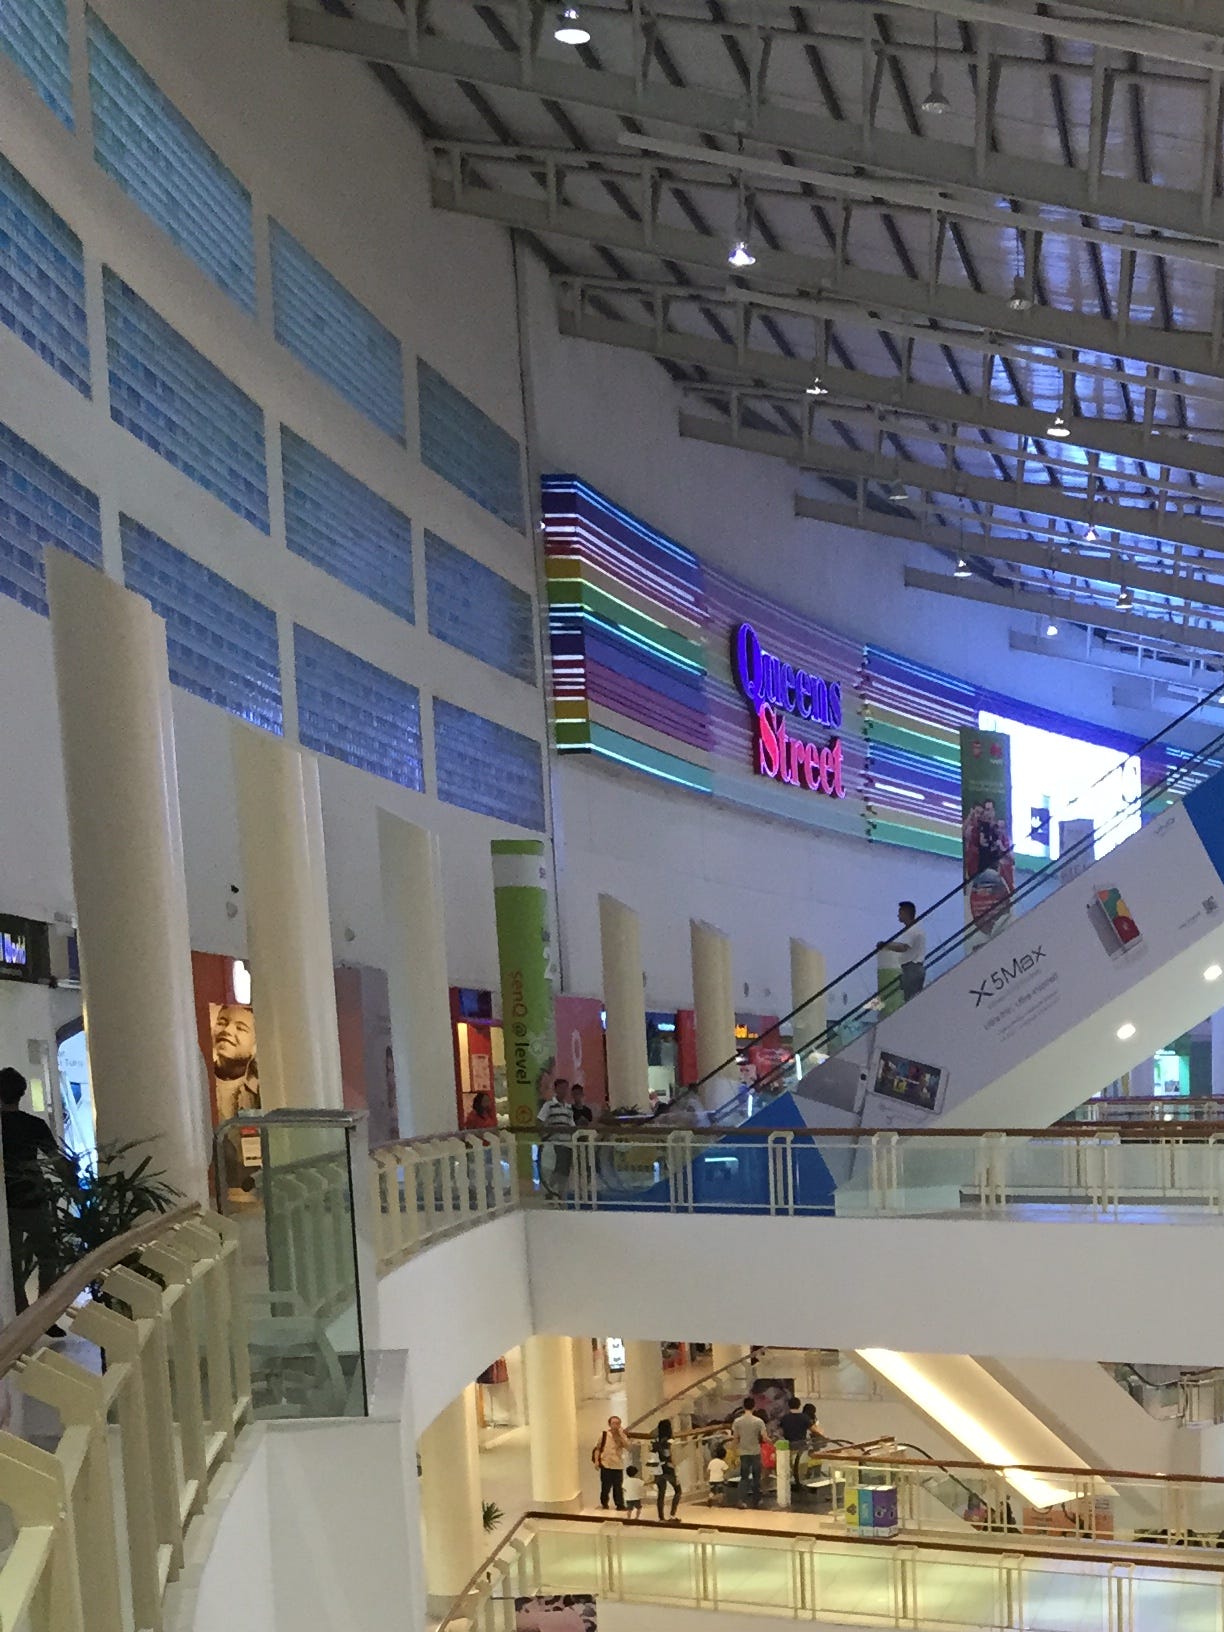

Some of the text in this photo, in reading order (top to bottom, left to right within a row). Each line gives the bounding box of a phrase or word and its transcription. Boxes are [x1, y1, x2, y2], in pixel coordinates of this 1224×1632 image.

[737, 623, 843, 729] Queens
[759, 702, 846, 799] Street
[515, 1042, 531, 1085] level
